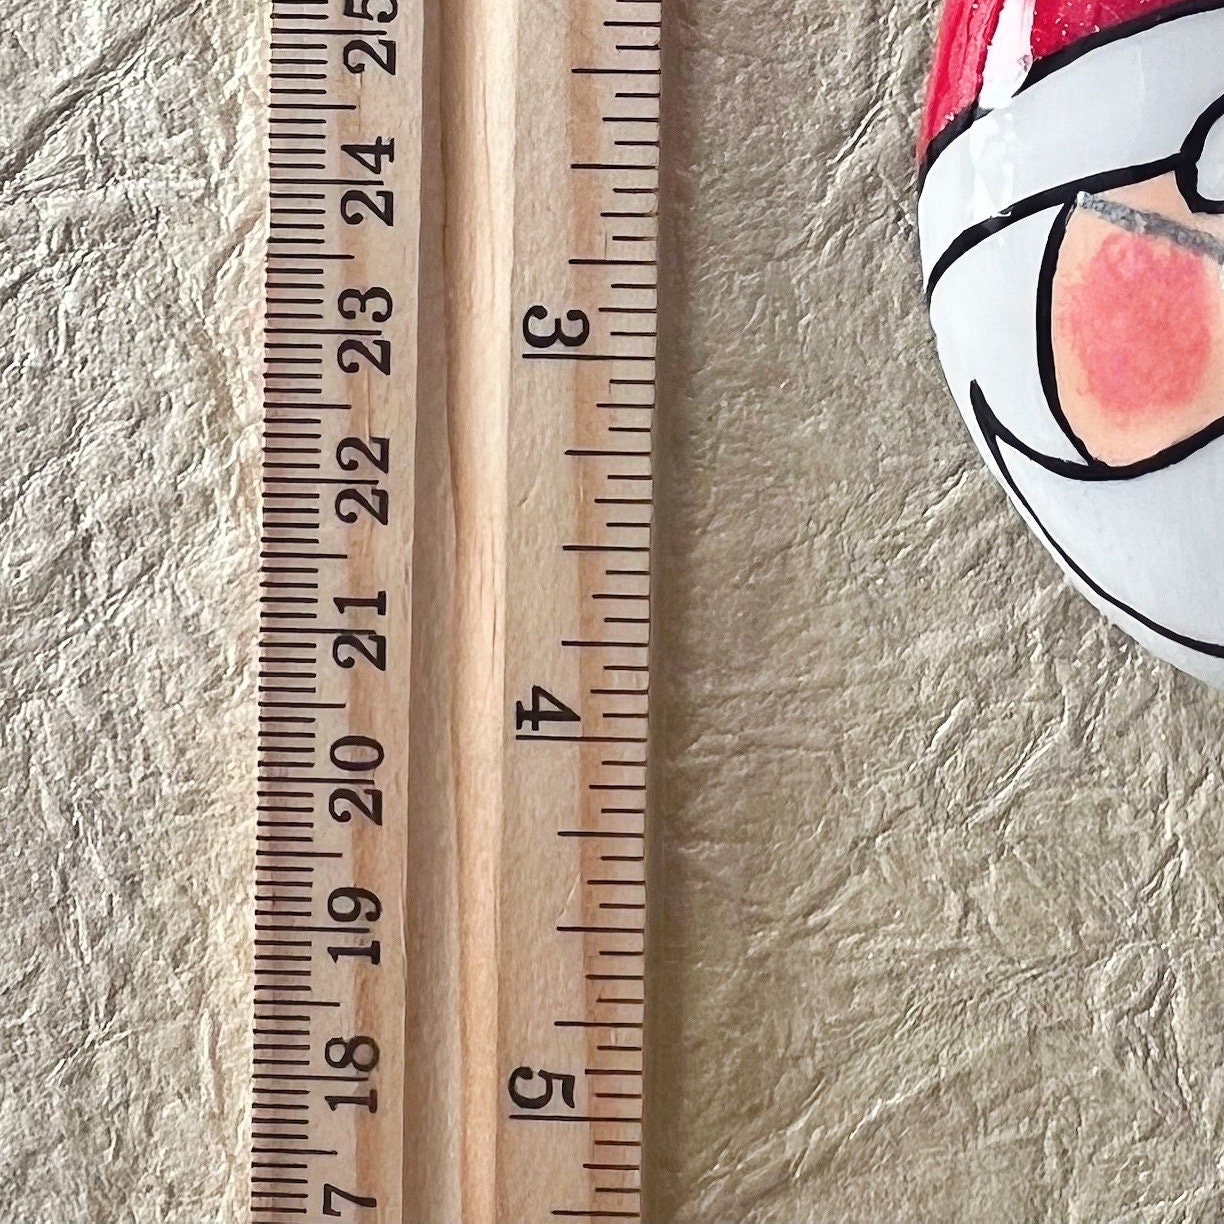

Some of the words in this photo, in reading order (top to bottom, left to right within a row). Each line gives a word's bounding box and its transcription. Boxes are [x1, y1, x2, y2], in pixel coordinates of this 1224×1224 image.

[341, 136, 394, 227] 24
[337, 287, 393, 375] 23
[523, 305, 589, 349] 3
[335, 436, 389, 525] 22
[332, 591, 386, 671] 21
[516, 685, 581, 731] 4
[329, 736, 384, 825] 20
[327, 887, 382, 965] 19
[324, 1035, 379, 1113] 18
[508, 1066, 575, 1109] 5
